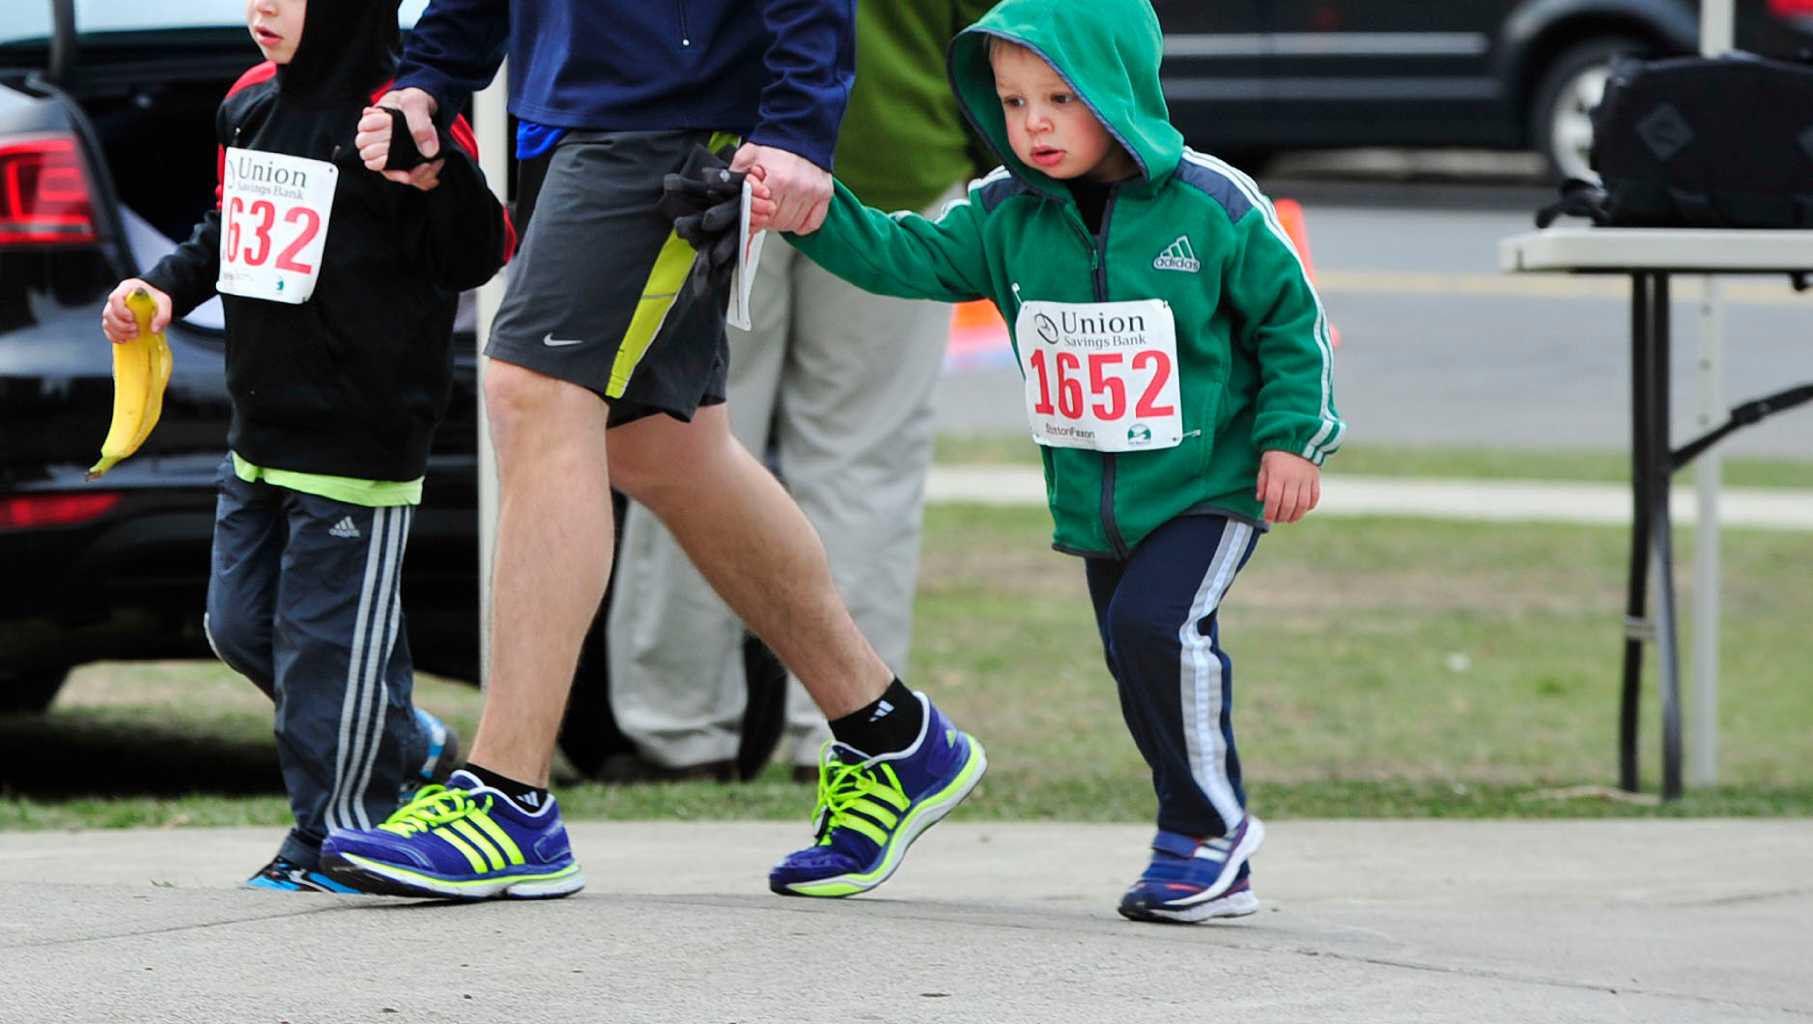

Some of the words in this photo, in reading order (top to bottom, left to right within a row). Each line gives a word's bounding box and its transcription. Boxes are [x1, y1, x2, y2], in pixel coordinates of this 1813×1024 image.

[238, 156, 307, 188] Union
[1155, 257, 1200, 271] adidas
[1061, 311, 1145, 334] Union
[1064, 337, 1110, 350] Savings
[1112, 336, 1147, 346] Bank
[1030, 349, 1175, 421] 1652
